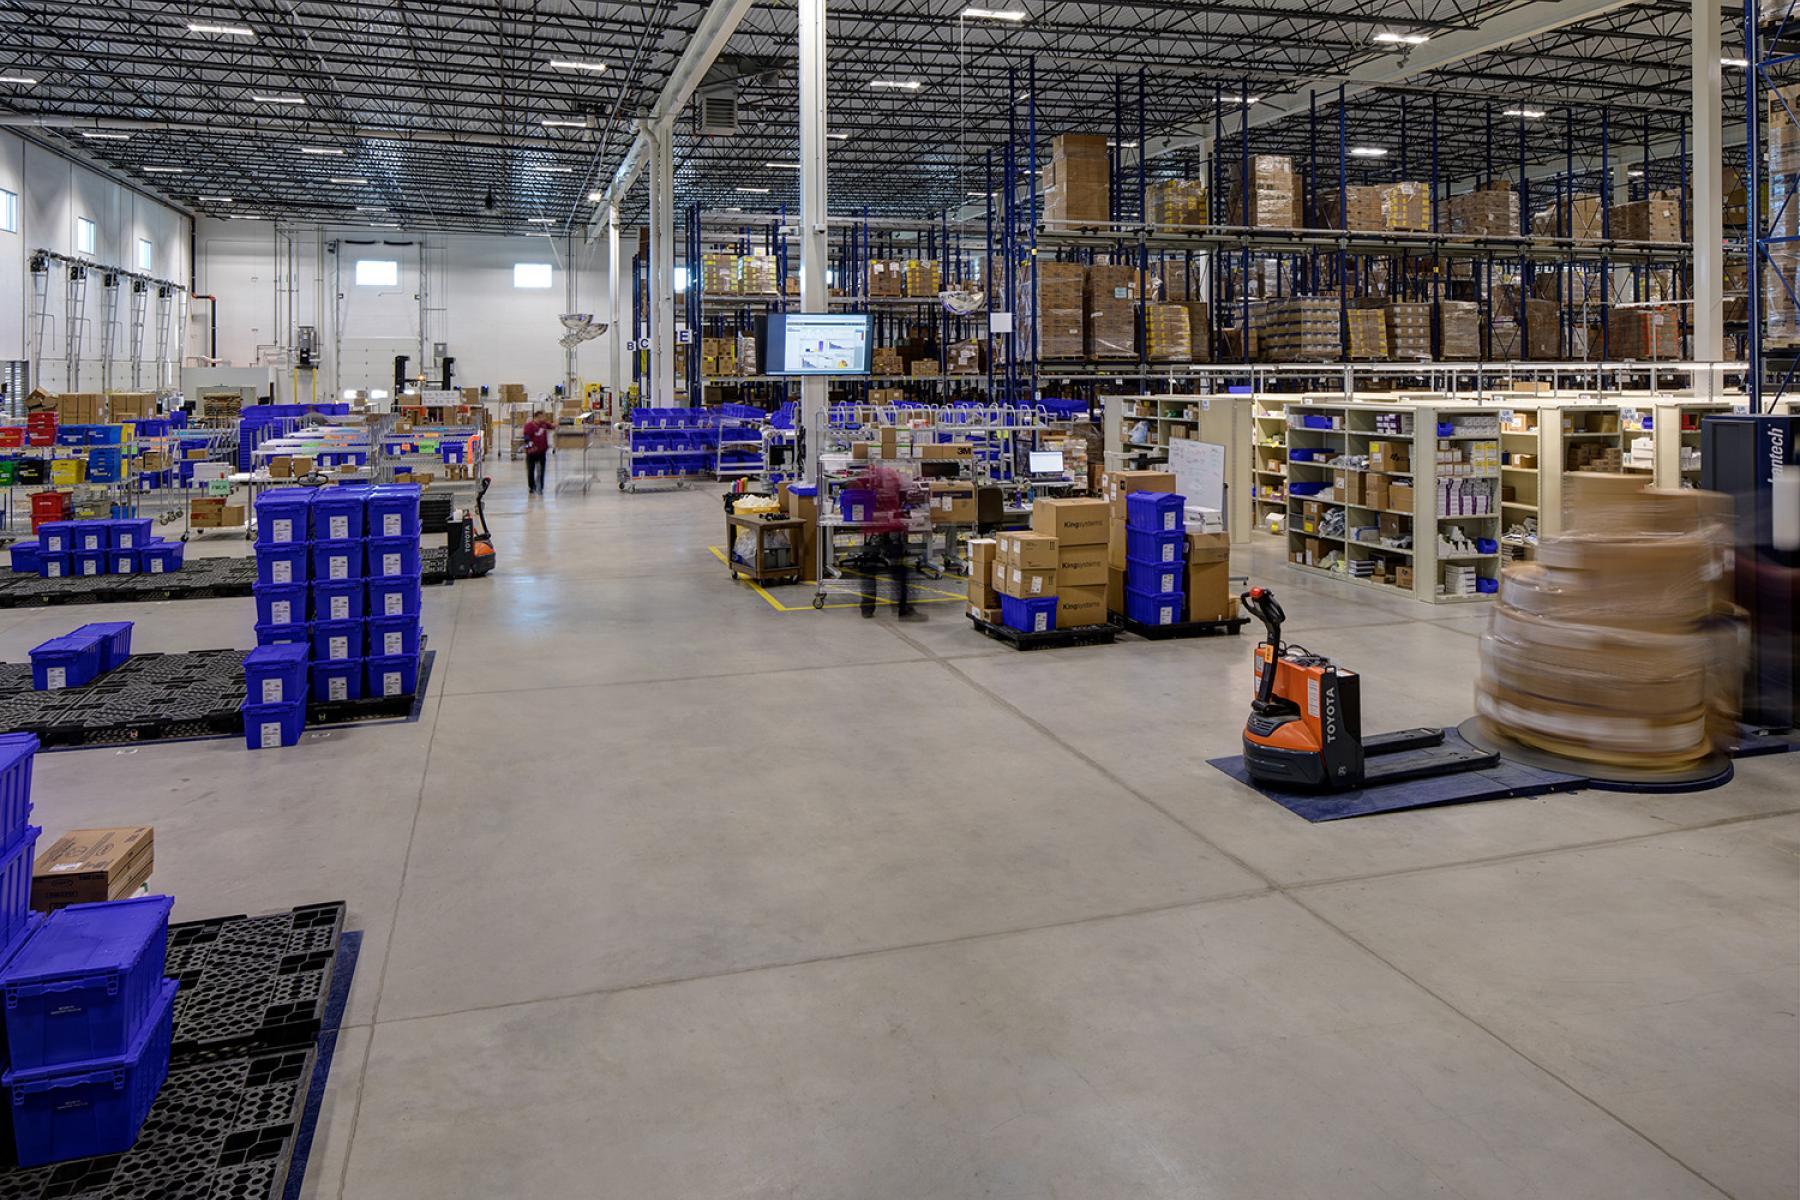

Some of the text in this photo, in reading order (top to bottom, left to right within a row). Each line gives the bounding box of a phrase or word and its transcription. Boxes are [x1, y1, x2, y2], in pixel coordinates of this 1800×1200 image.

[680, 330, 689, 342] E
[626, 341, 635, 351] B
[640, 338, 649, 349] C
[1326, 687, 1337, 744] TOYOTA
